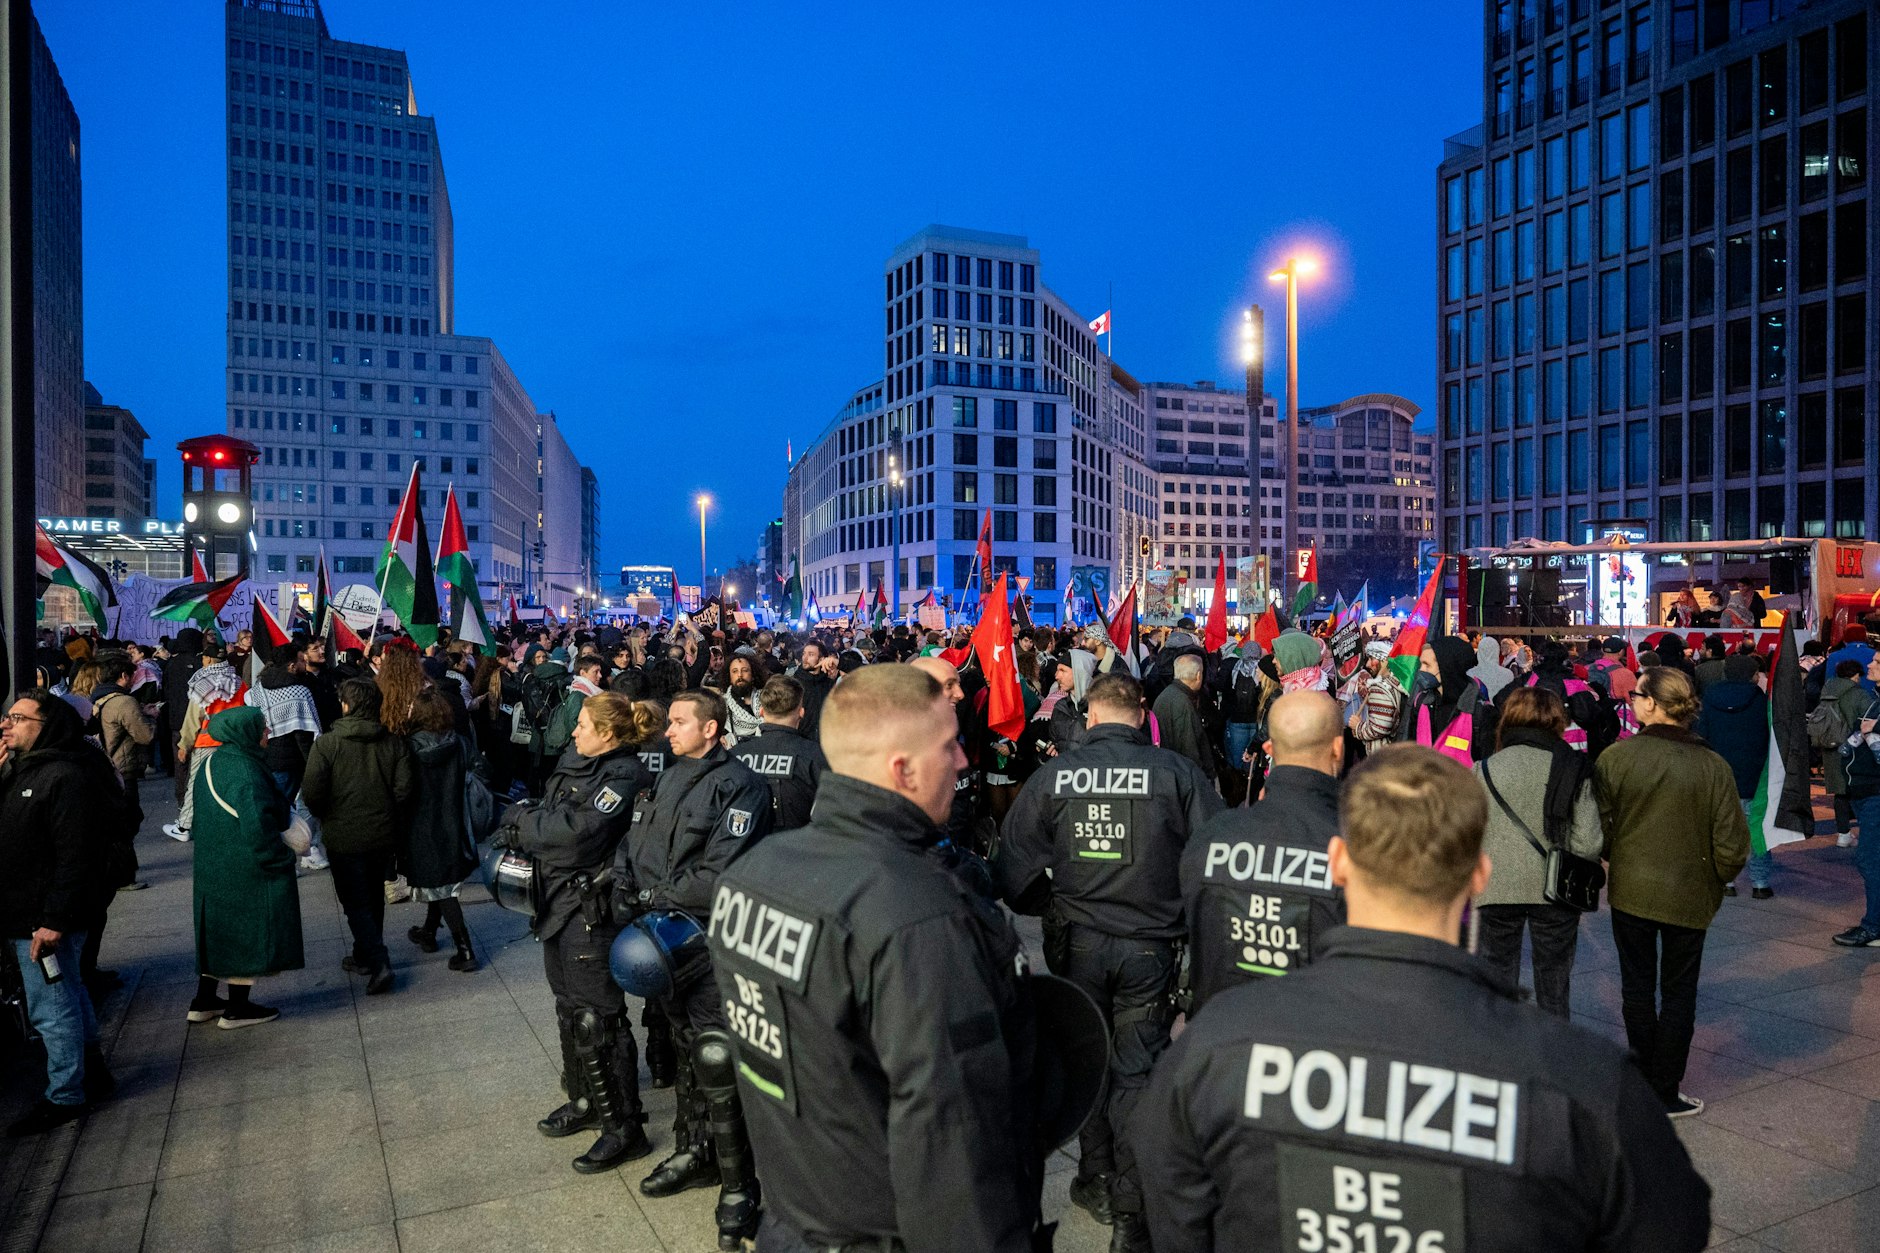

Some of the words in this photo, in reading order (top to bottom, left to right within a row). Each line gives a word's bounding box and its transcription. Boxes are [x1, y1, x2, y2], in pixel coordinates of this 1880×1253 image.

[735, 753, 793, 775] OLIZEI
[1055, 767, 1149, 795] POLIZEI
[1074, 822, 1126, 840] 35110
[1087, 803, 1111, 821] BE
[1204, 841, 1333, 891] POLIZEI
[1249, 894, 1282, 922] BE
[707, 885, 814, 983] POLIZEI
[1230, 916, 1301, 950] 35101
[734, 972, 767, 1015] BE
[726, 999, 783, 1060] 35125
[1243, 1042, 1519, 1165] POLIZEI
[1332, 1164, 1404, 1221] BE
[1296, 1207, 1446, 1253] 35126
